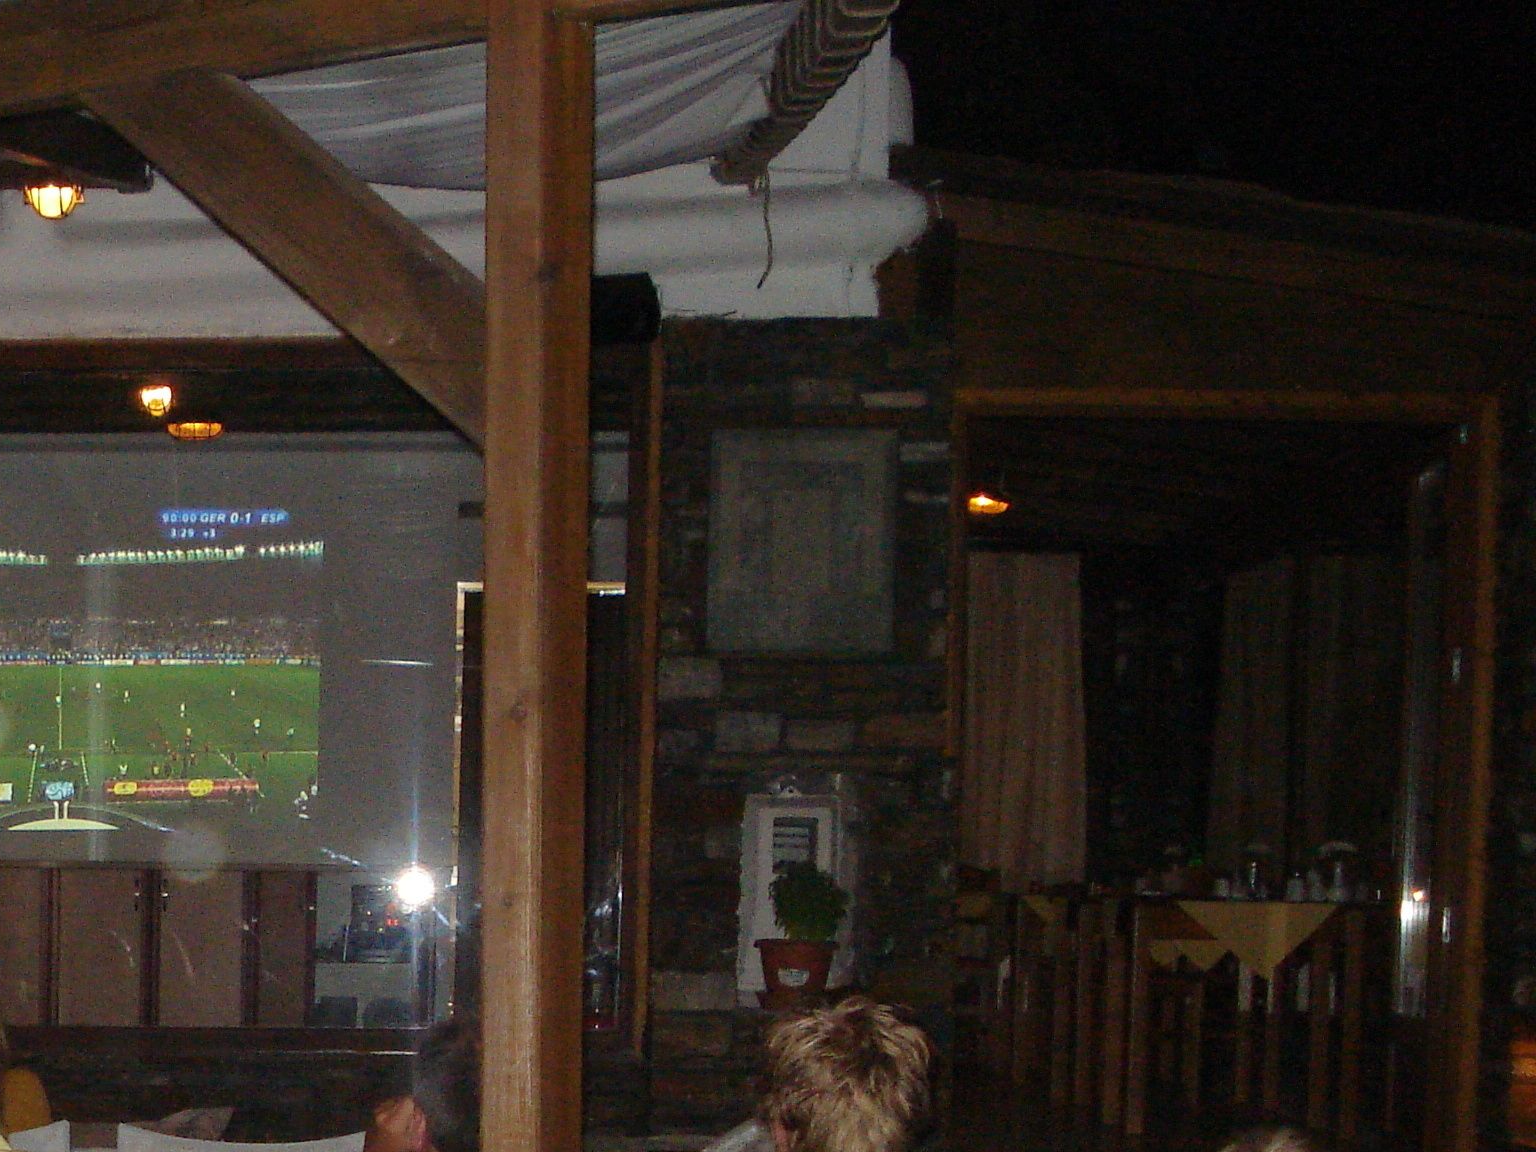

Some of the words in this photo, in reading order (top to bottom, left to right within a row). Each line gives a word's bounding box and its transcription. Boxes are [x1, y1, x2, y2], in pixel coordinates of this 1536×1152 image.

[200, 512, 226, 523] GER
[230, 511, 252, 524] 0-1
[261, 513, 285, 524] ESP
